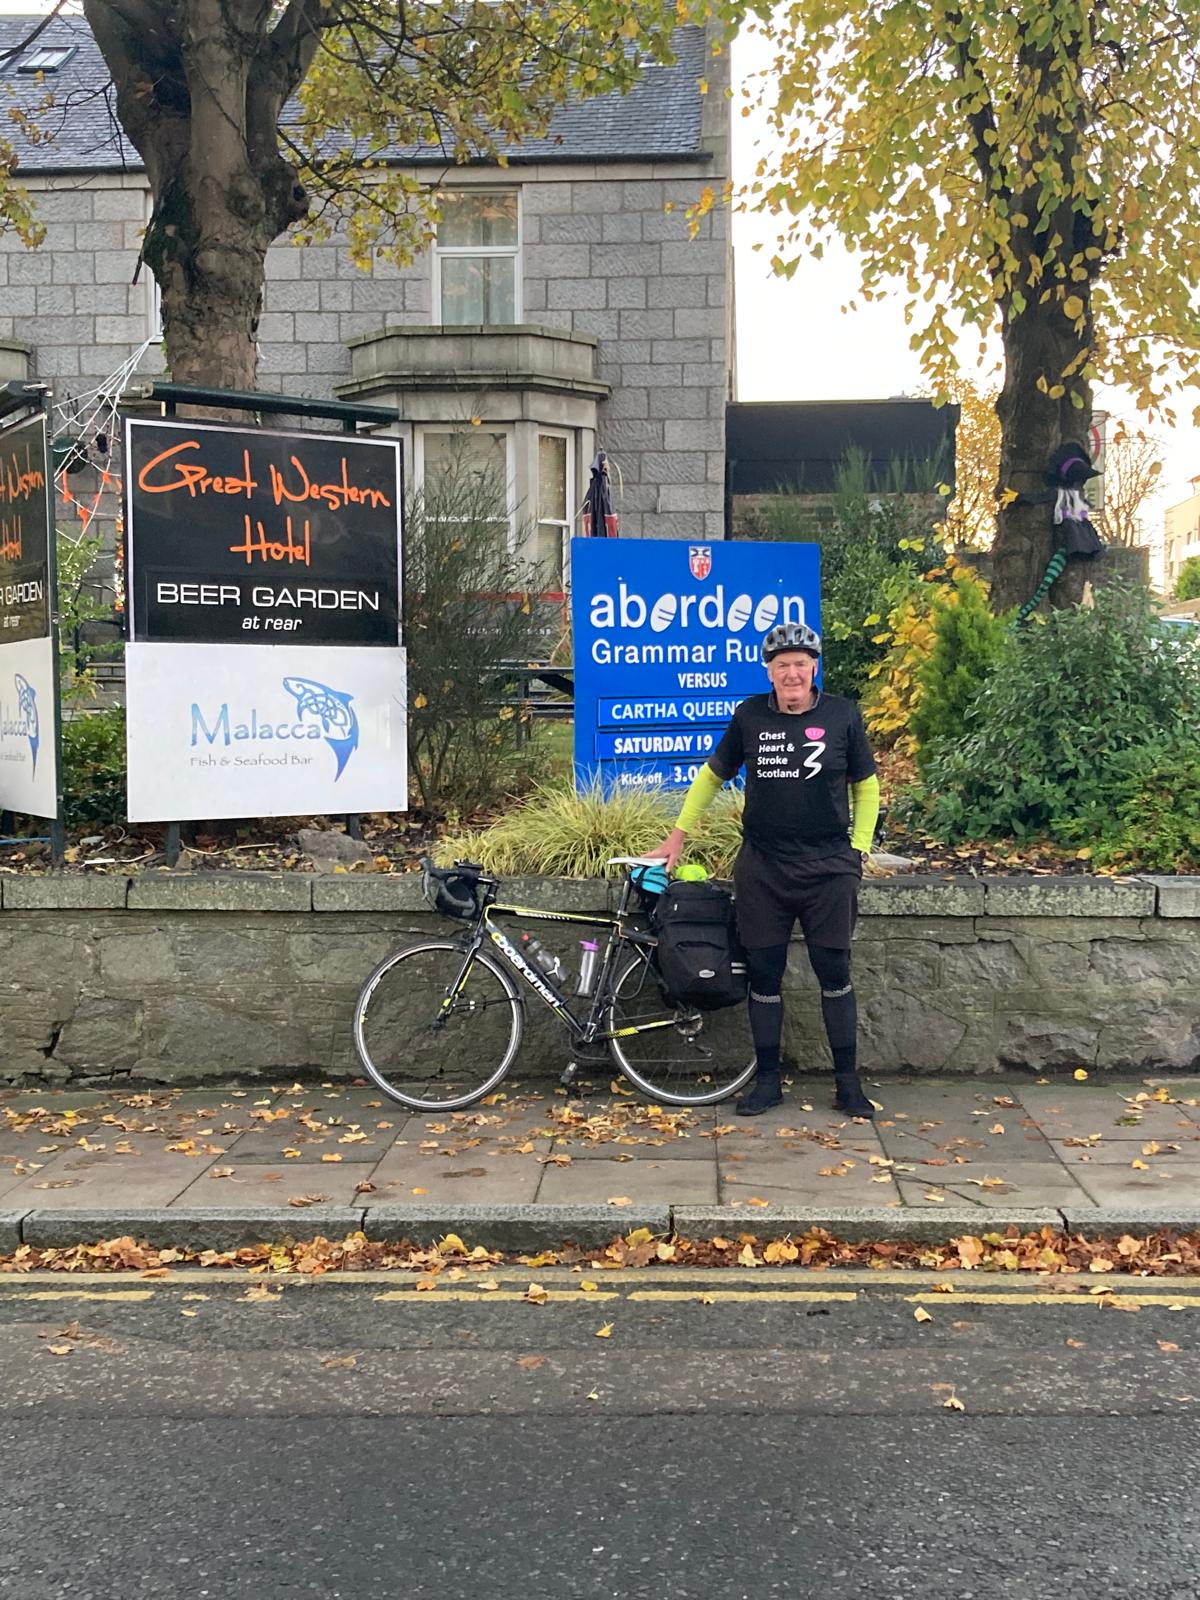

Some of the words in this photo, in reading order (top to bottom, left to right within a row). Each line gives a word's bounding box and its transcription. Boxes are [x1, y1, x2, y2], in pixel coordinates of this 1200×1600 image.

[138, 441, 257, 499] Great
[269, 455, 391, 511] Western
[229, 514, 312, 567] Hotel
[5, 579, 43, 605] GARDEN
[156, 582, 241, 607] BEER
[251, 586, 379, 611] GARDEN
[241, 617, 259, 631] at
[264, 618, 302, 632] rear
[591, 638, 717, 666] Grammar
[726, 638, 768, 668] Ru
[677, 672, 727, 689] VERSUS
[611, 703, 678, 720] CARTHA
[0, 704, 28, 742] alacca
[191, 703, 321, 746] Malacca
[614, 735, 694, 754] SATURDAY
[697, 734, 713, 751] 19
[759, 731, 786, 741] Chest
[759, 744, 785, 753] Heart
[786, 742, 795, 752] &
[190, 753, 216, 767] Fish
[220, 756, 230, 767] &
[234, 753, 288, 767] Seafood
[291, 755, 313, 766] Bar
[757, 755, 788, 765] Stroke
[621, 772, 662, 785] Kick-off
[674, 766, 699, 783] 3.0
[757, 768, 800, 778] Scotland
[497, 935, 561, 1008] boardman
